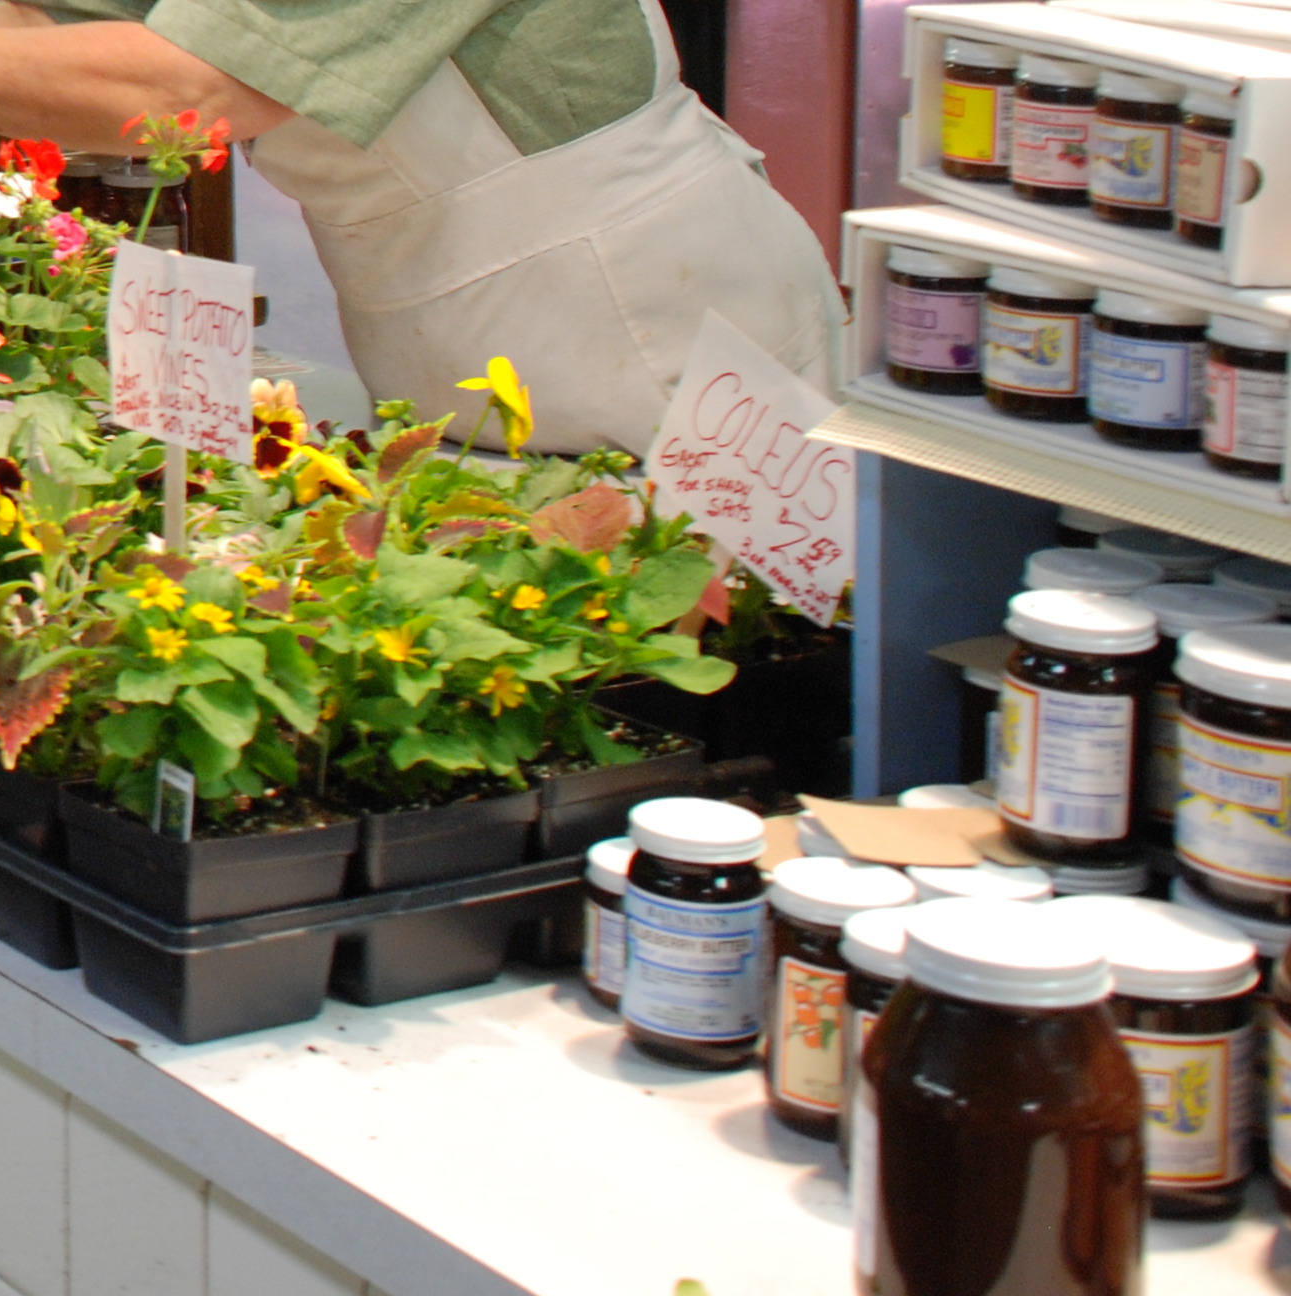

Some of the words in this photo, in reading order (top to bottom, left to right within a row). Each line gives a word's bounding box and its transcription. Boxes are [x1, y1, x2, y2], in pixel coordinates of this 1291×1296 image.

[120, 278, 175, 341] SWEET
[180, 288, 248, 357] POTATO
[150, 344, 210, 398] VINES
[693, 371, 851, 522] COLEUS
[705, 477, 755, 506] SHADY
[701, 937, 751, 954] BUTTER
